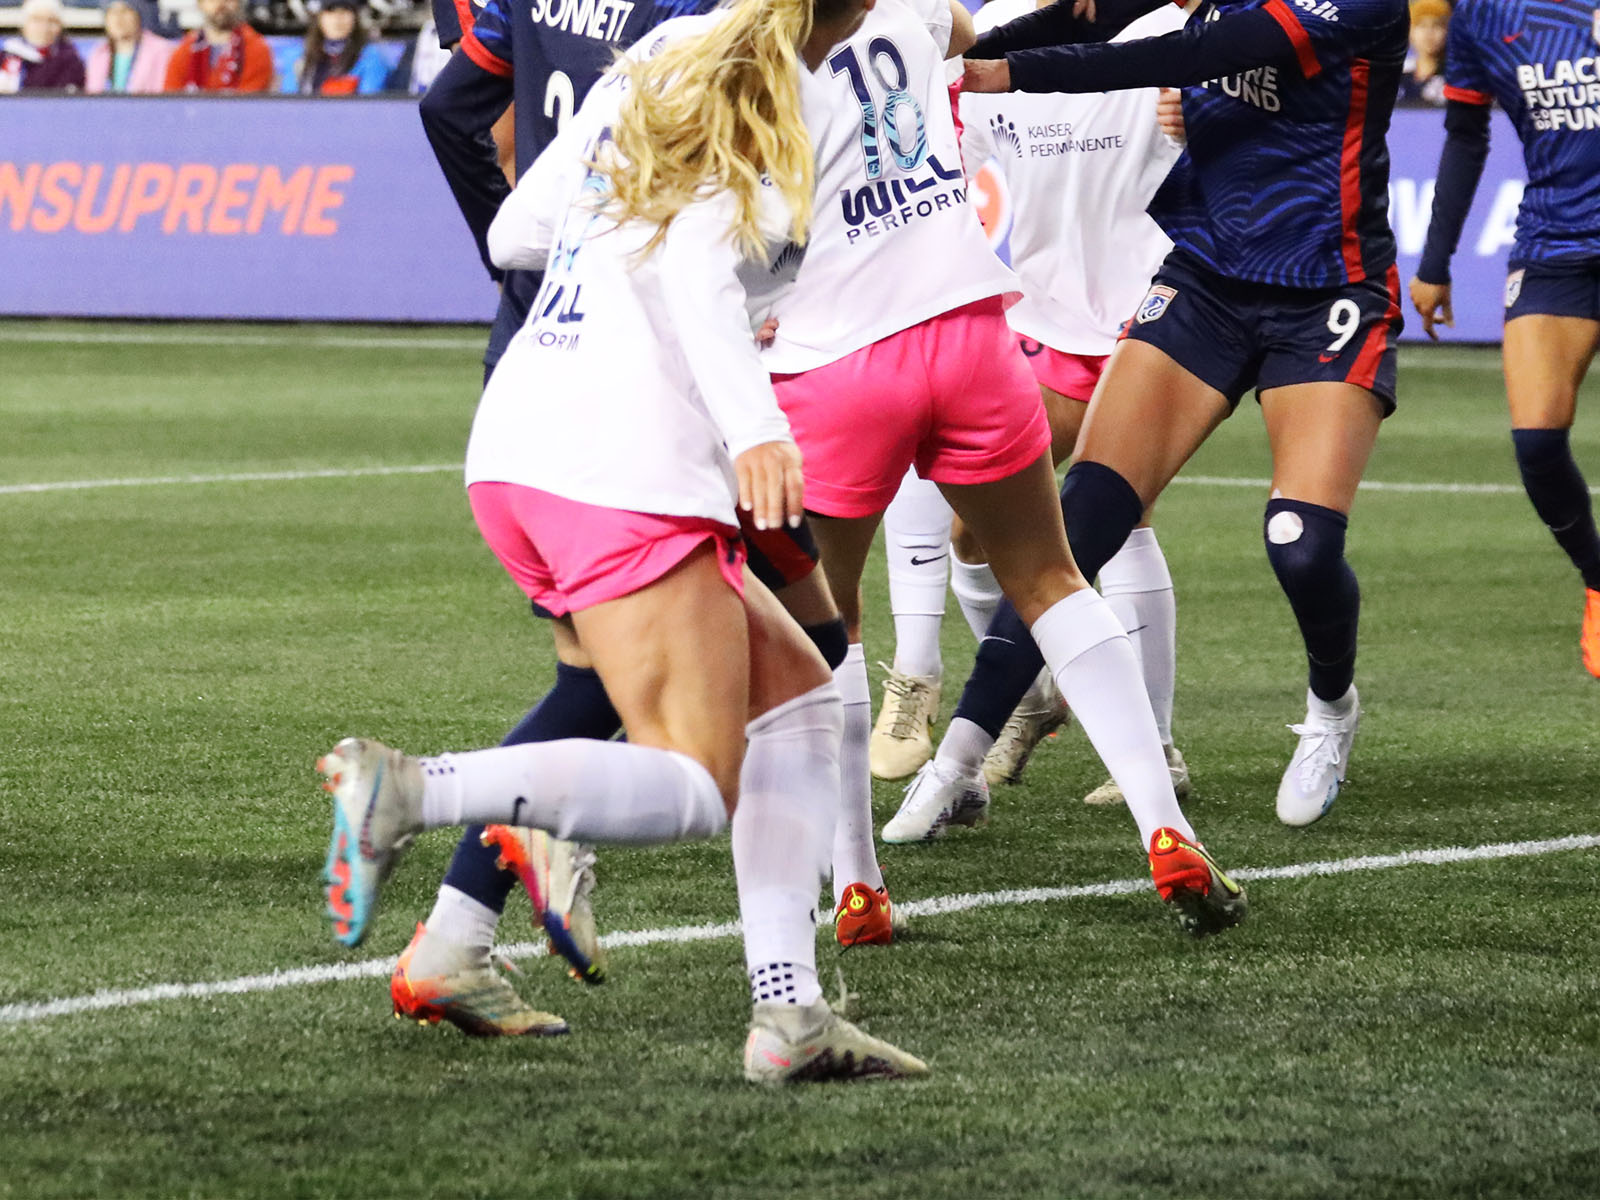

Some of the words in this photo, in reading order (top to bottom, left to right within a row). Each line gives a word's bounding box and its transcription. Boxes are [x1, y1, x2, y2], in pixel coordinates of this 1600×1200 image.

[1027, 122, 1073, 139] KAISER
[1030, 135, 1124, 158] PERMANENTE
[1326, 298, 1361, 352] 9
